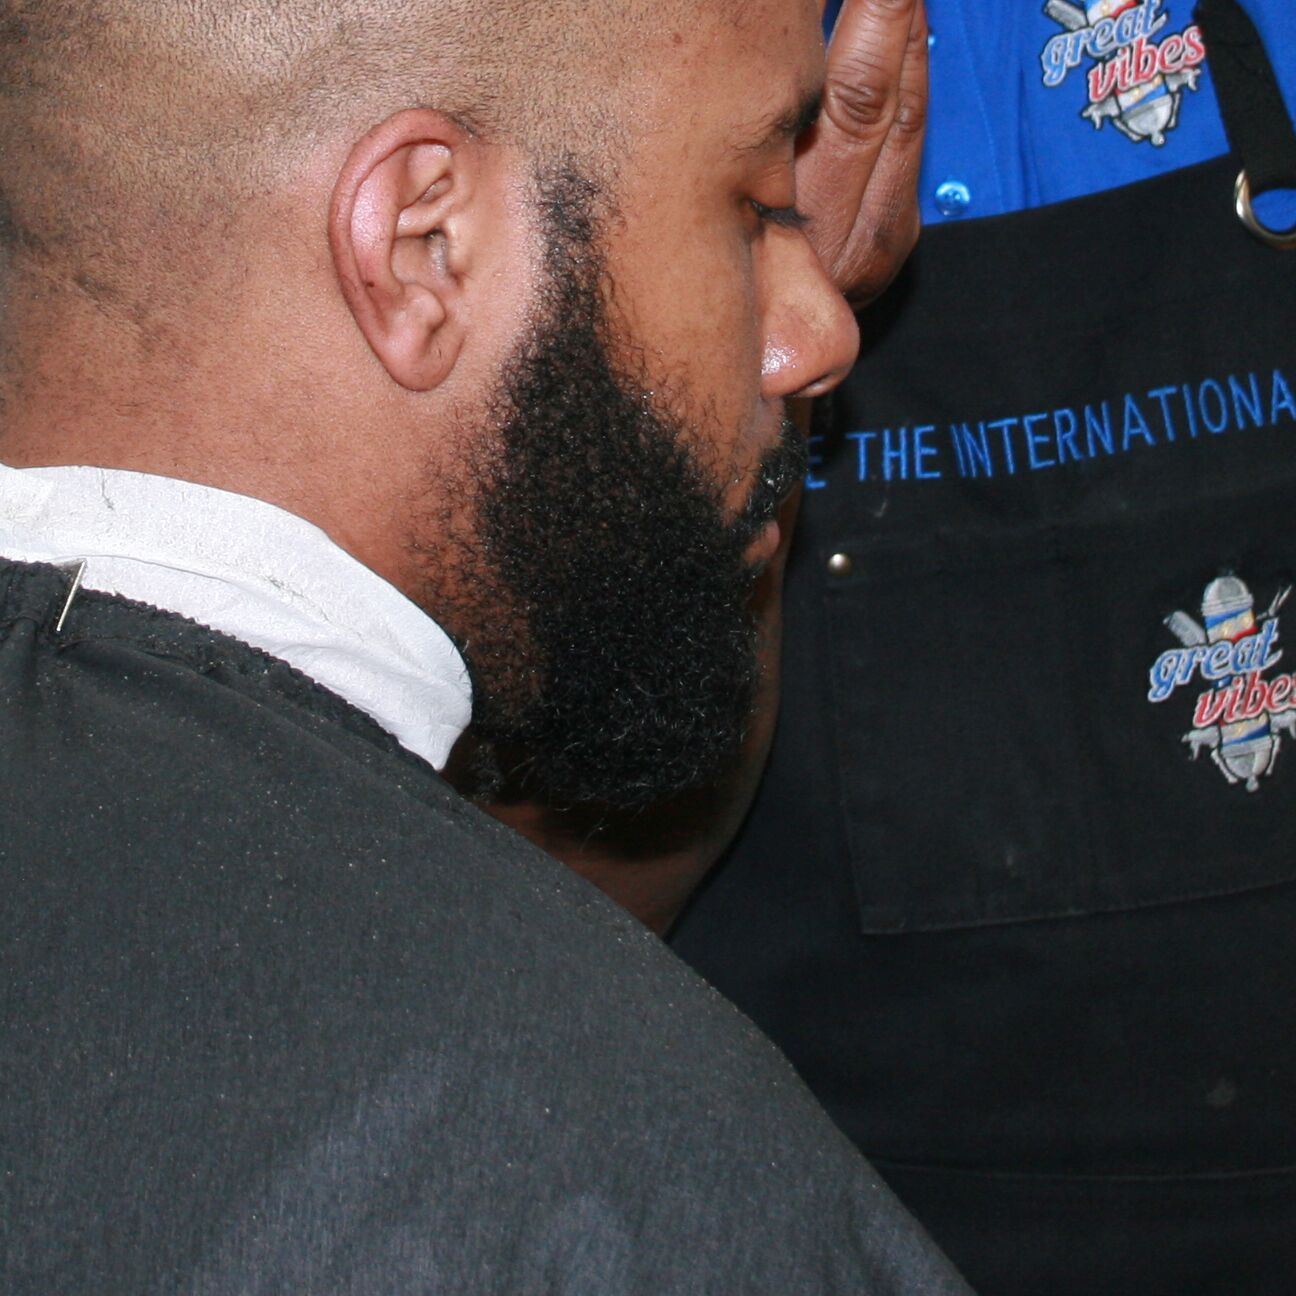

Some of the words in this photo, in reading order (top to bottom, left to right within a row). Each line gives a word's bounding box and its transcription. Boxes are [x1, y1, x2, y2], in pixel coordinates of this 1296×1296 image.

[1088, 25, 1205, 102] vibes
[845, 424, 941, 481] THE
[1148, 617, 1283, 702] great
